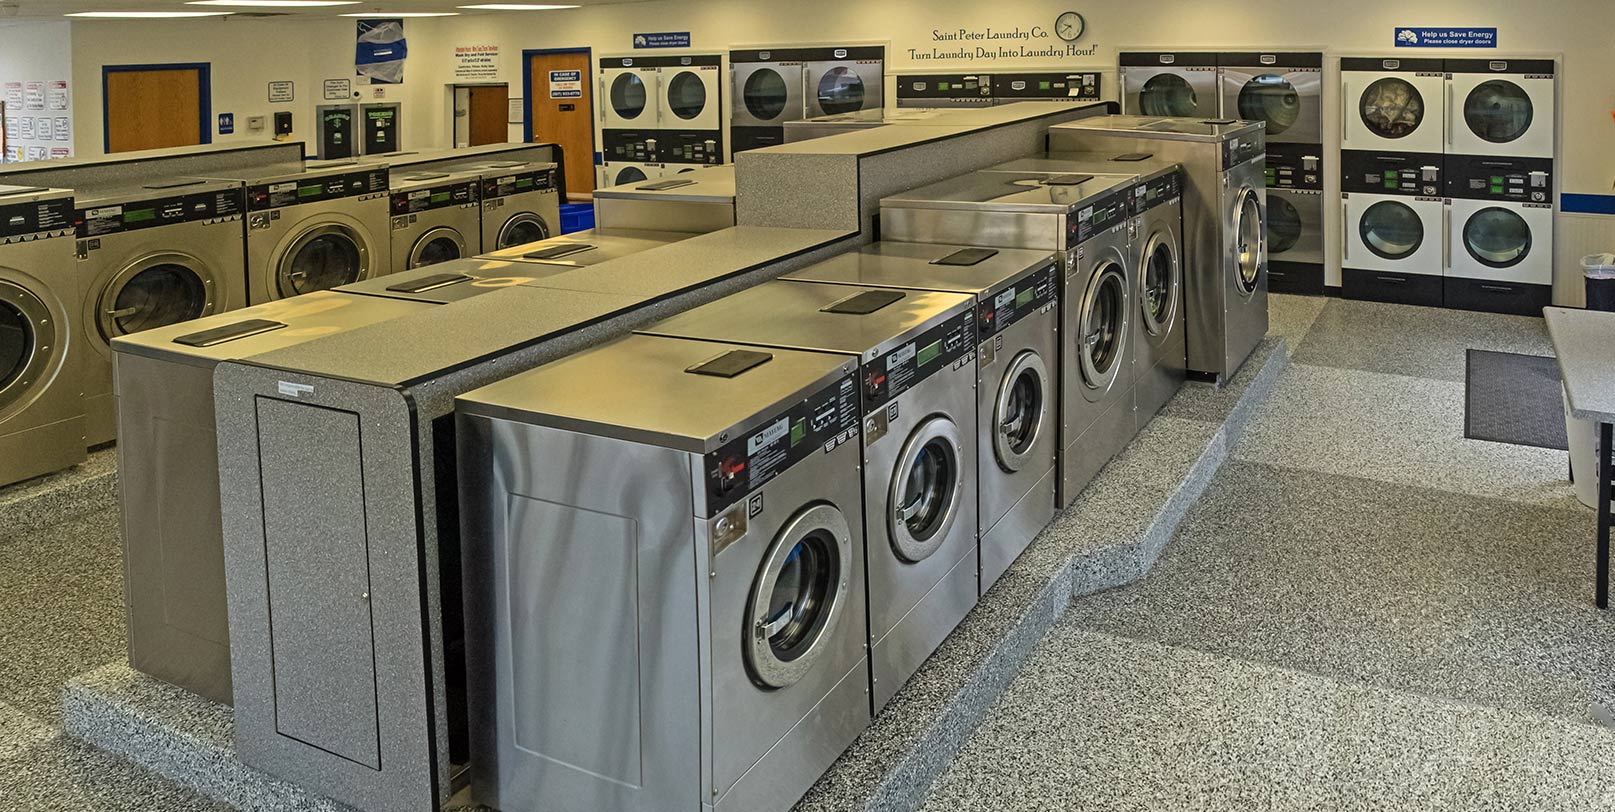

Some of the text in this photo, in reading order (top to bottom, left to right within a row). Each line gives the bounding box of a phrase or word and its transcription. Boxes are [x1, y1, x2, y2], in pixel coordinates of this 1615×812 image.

[932, 26, 1049, 42] Saint Peter Laundry Co.
[1468, 31, 1493, 39] Energy
[933, 47, 974, 60] Laundry
[976, 46, 997, 60] Day
[999, 46, 1019, 58] Into
[1020, 45, 1064, 59] Laundry
